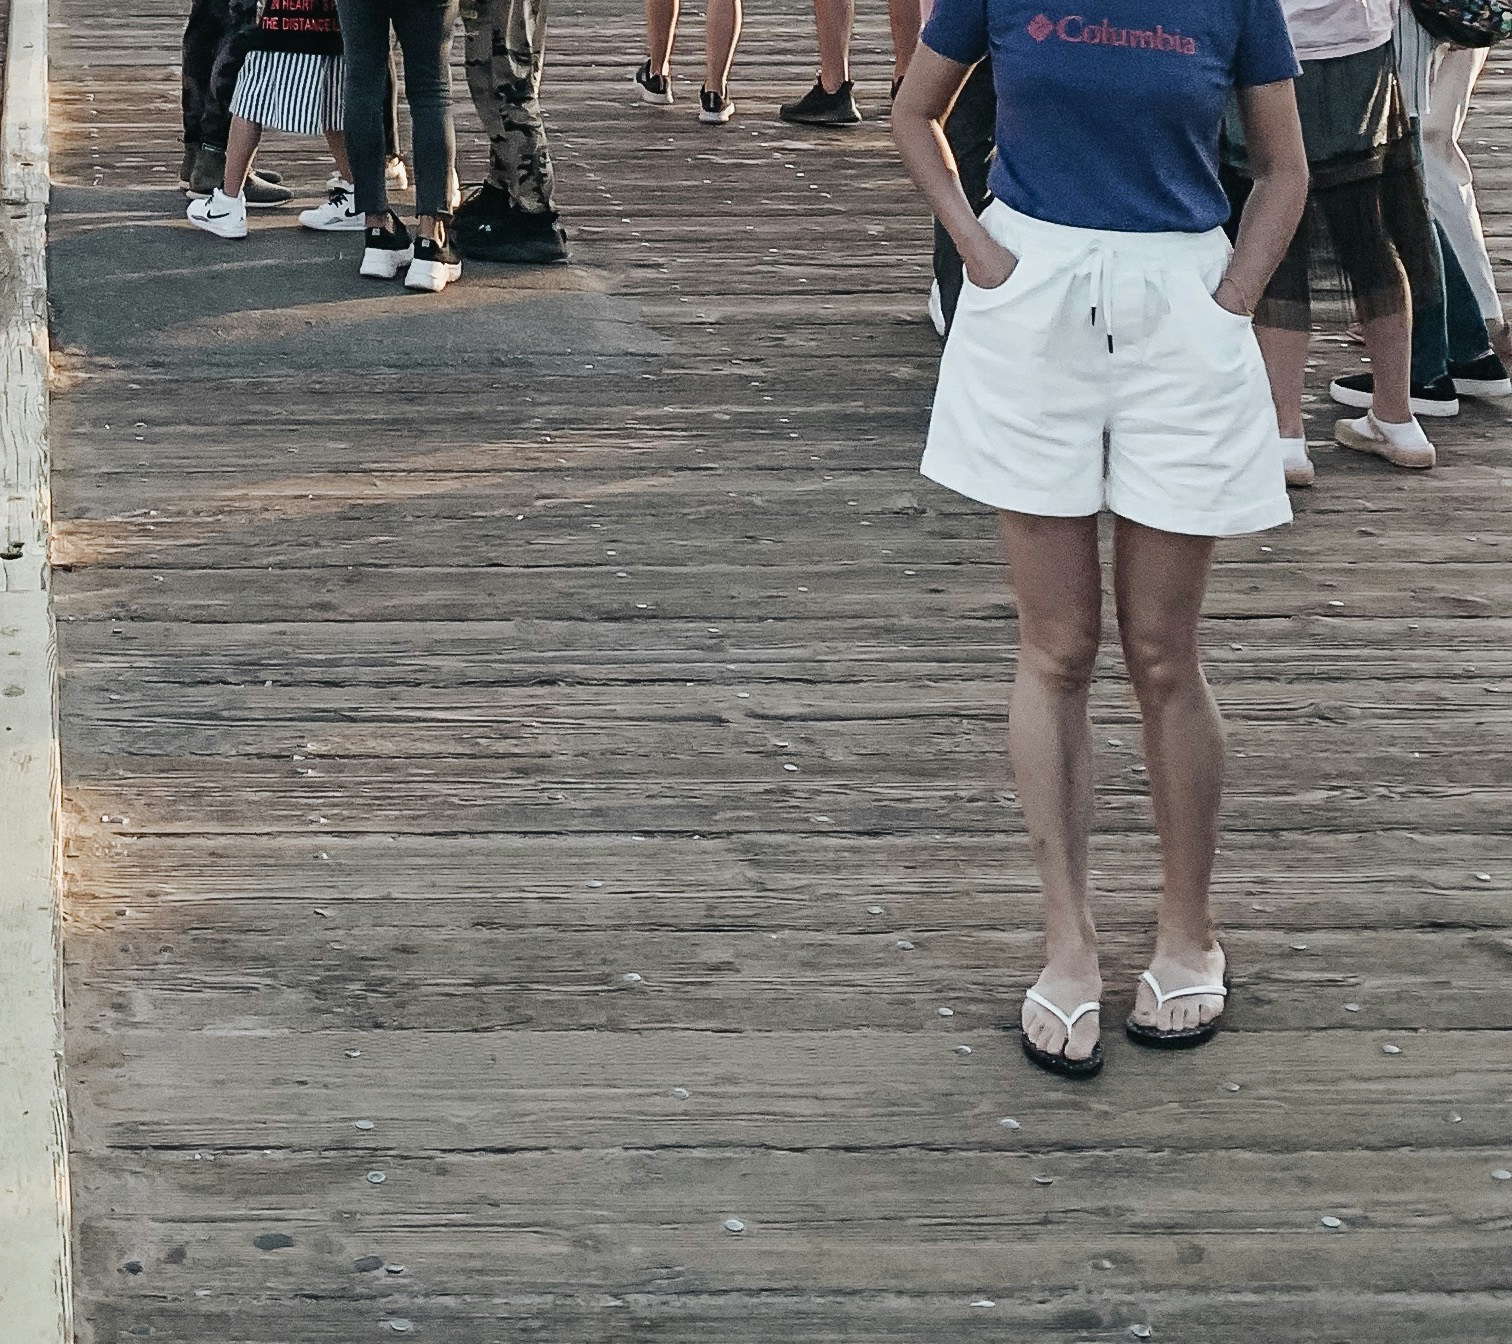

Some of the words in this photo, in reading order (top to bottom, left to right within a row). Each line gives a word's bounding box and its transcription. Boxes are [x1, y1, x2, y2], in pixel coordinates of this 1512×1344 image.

[262, 16, 279, 29] THE
[283, 17, 330, 31] DISTANCE
[1056, 15, 1197, 55] Columbia
